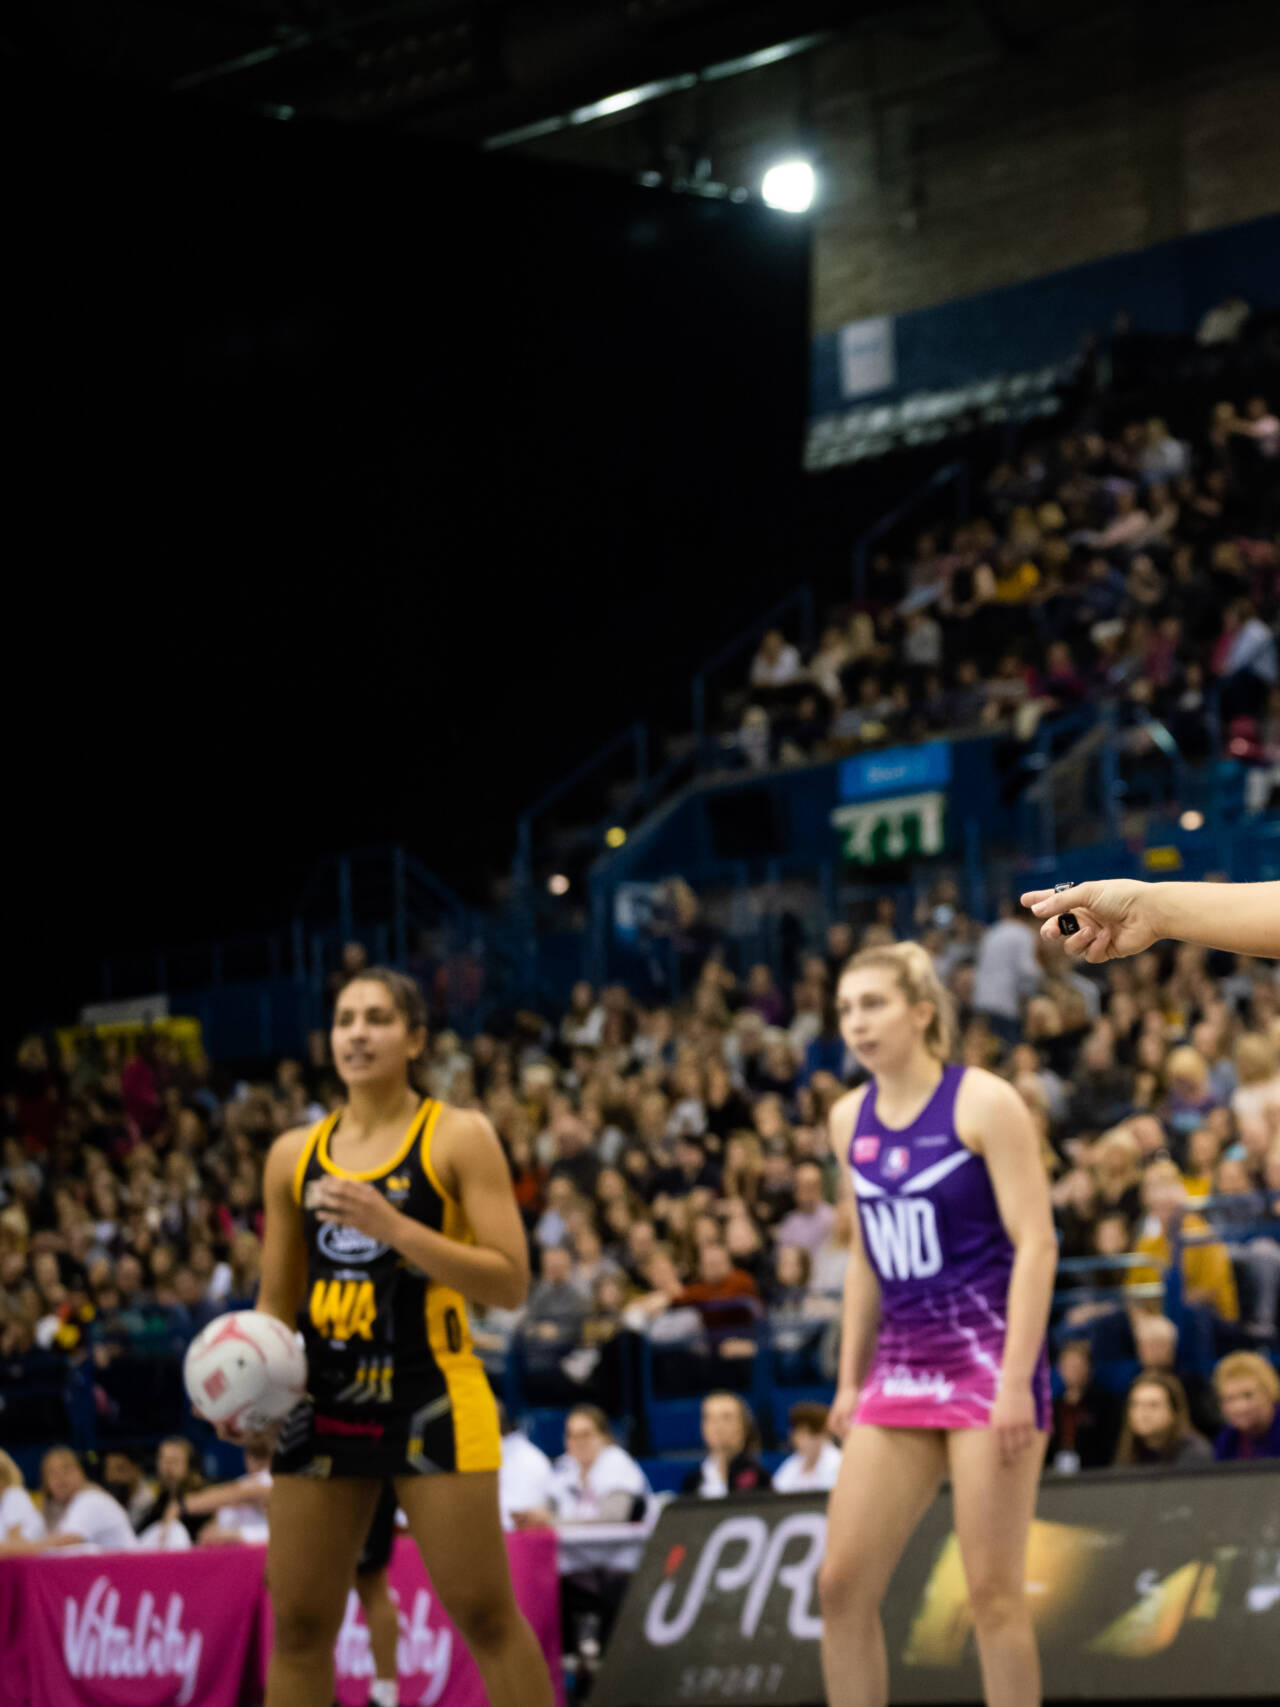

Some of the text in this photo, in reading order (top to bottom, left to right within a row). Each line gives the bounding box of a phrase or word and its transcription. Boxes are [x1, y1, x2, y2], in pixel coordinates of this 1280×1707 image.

[860, 1198, 943, 1281] WD
[309, 1278, 377, 1341] WA
[63, 1575, 202, 1706] Vitality
